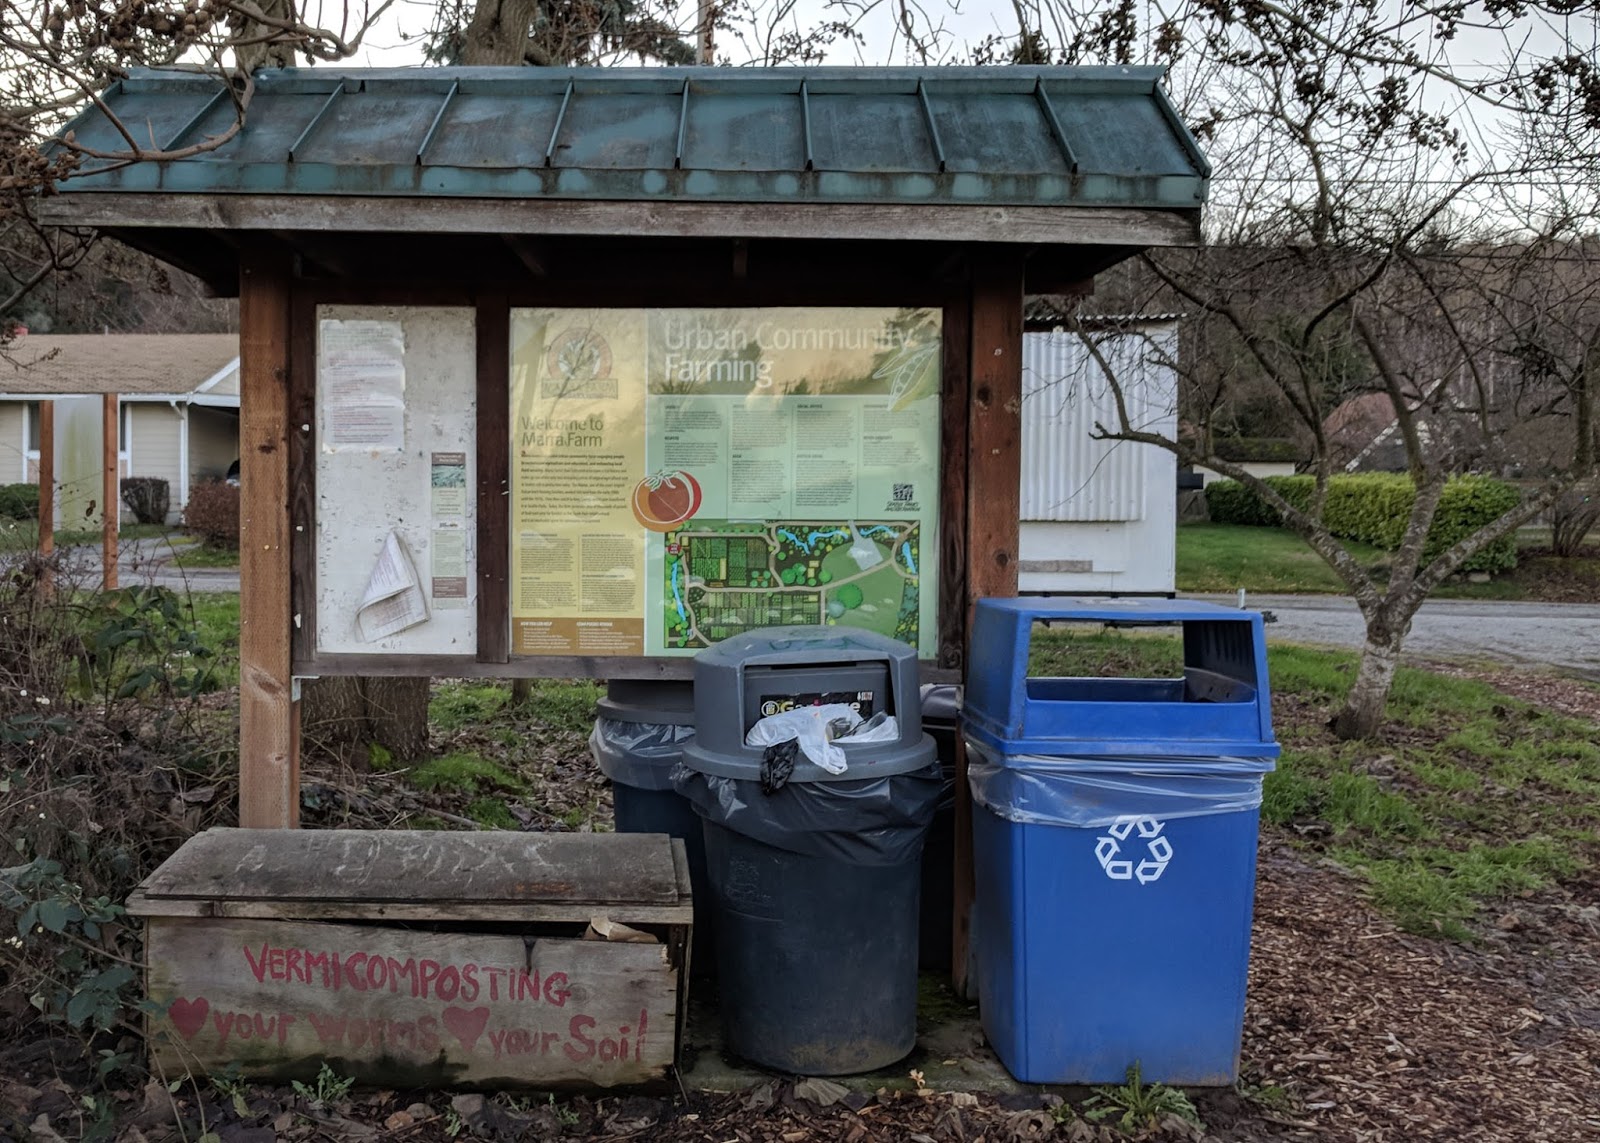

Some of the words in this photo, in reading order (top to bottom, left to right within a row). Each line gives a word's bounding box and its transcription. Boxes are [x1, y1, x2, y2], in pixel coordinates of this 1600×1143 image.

[664, 321, 747, 350] Urban
[755, 322, 914, 356] Community
[664, 352, 774, 388] Farming
[521, 416, 587, 430] Welcome
[589, 417, 604, 431] to
[567, 432, 602, 447] Farm
[243, 943, 572, 1007] VERMICOMPOSTING
[213, 1010, 296, 1054] your
[488, 1029, 560, 1061] your
